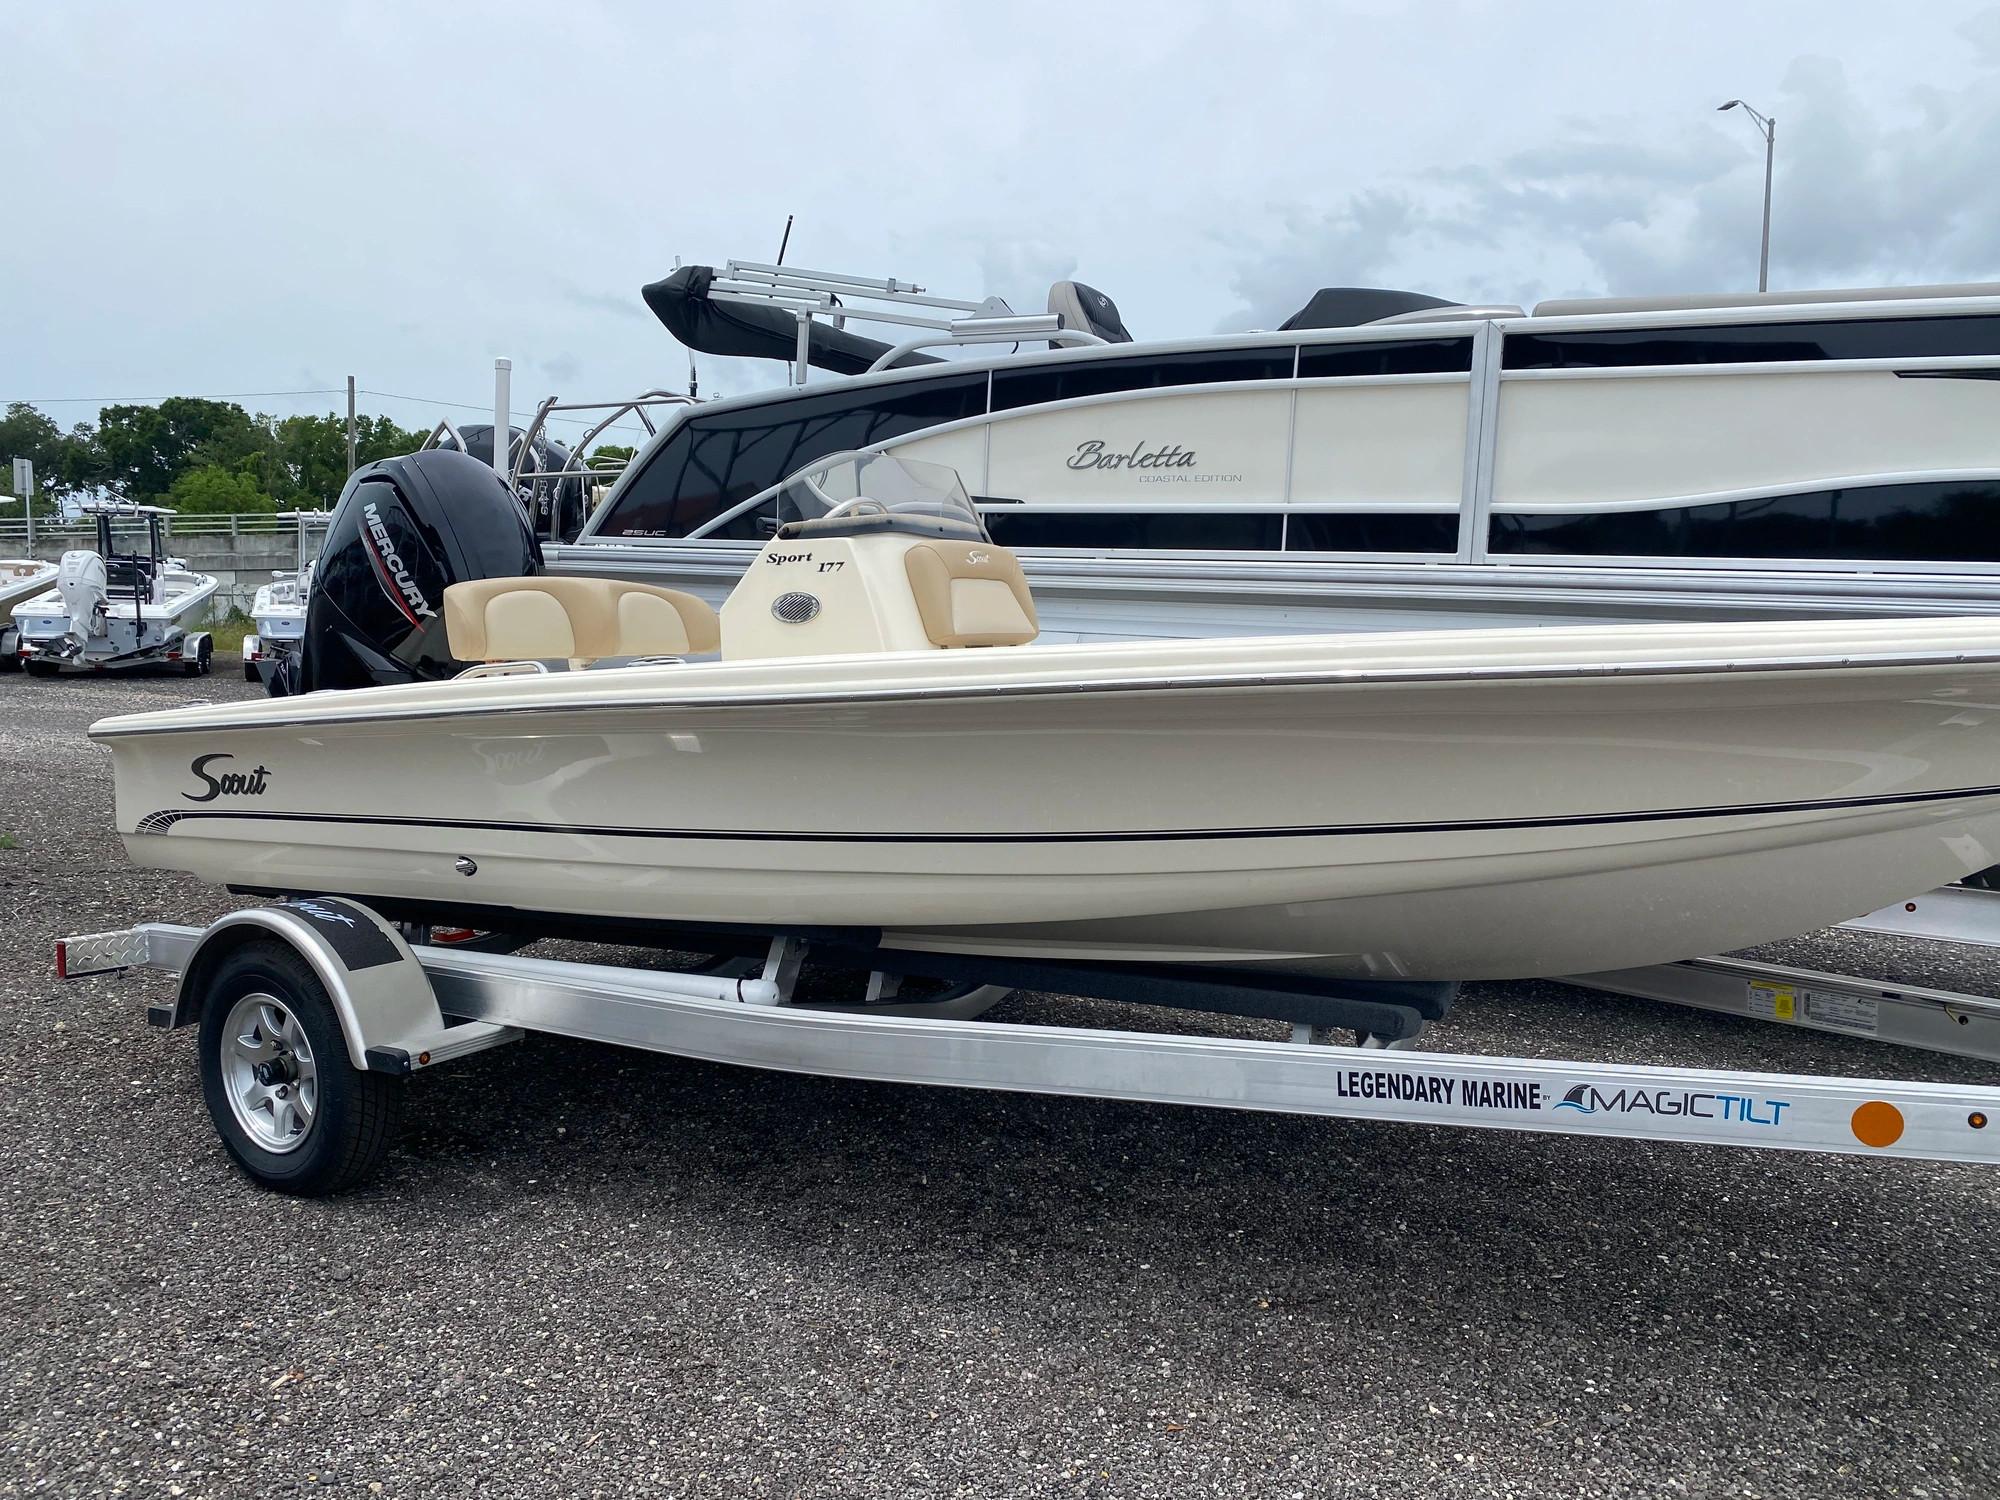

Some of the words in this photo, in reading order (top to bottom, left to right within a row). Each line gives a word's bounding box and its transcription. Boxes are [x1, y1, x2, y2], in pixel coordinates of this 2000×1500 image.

[1066, 440, 1197, 470] Barletta
[1139, 475, 1189, 483] COASTAL
[1194, 474, 1242, 483] EDITION
[363, 502, 438, 618] MERCURY
[766, 552, 813, 566] Sport
[817, 561, 845, 573] 177
[181, 753, 272, 802] Scout
[1337, 1071, 1455, 1105] LEGENDARY
[1462, 1079, 1541, 1110] MARINE
[1589, 1086, 1790, 1126] MAGICTILT
